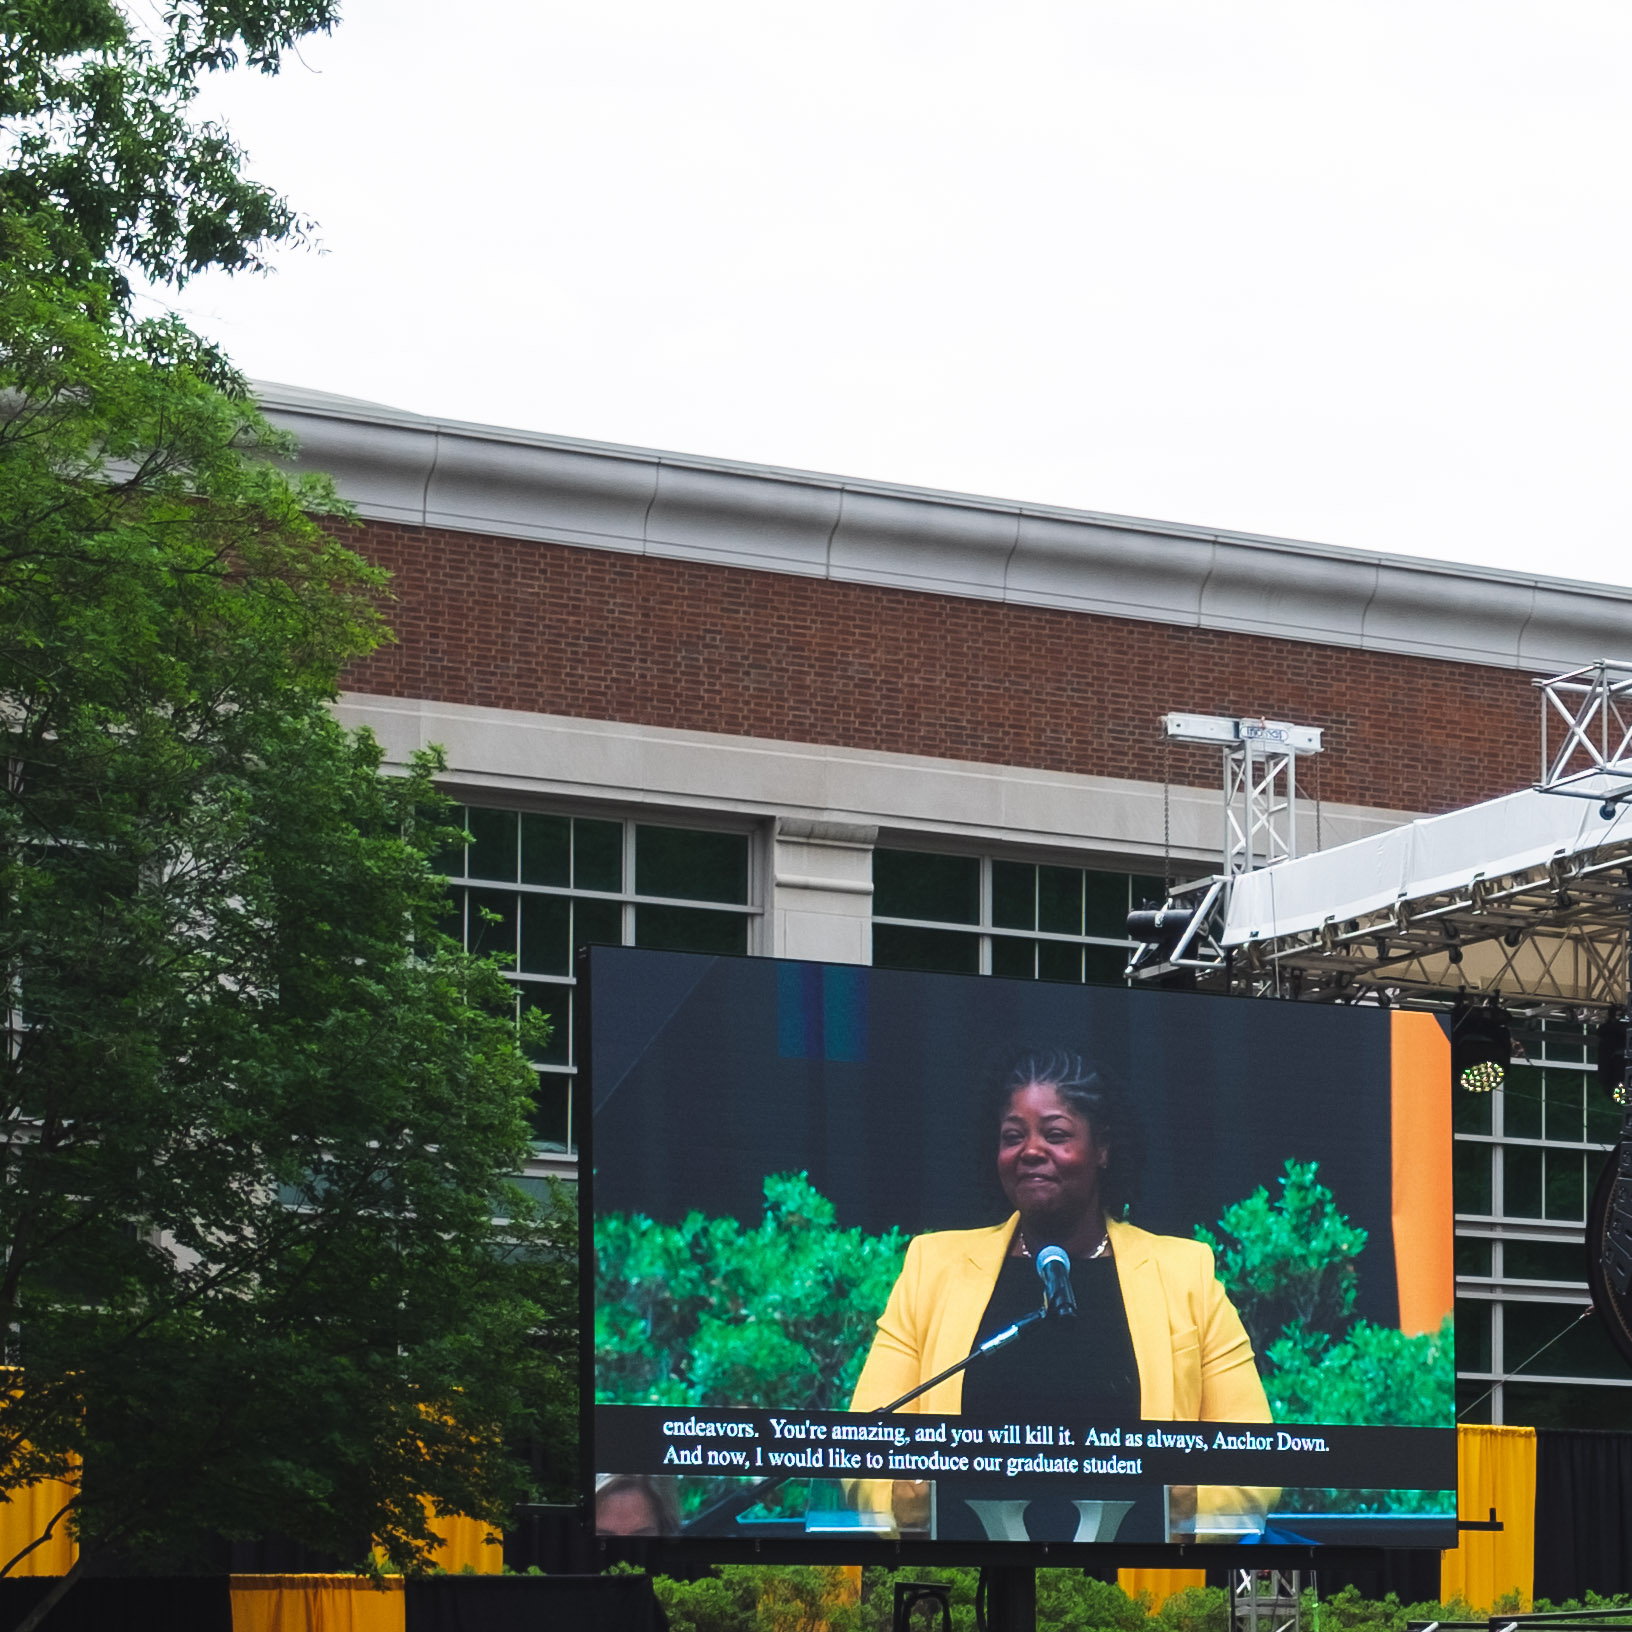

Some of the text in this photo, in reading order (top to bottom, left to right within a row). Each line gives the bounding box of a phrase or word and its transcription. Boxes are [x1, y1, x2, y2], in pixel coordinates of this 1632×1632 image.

[662, 1415, 1330, 1454] endeavors. You're amazing, and you will kill it. And as always, Anchor Down.
[662, 1444, 1143, 1477] And now, I would like to introduce our graduate student
